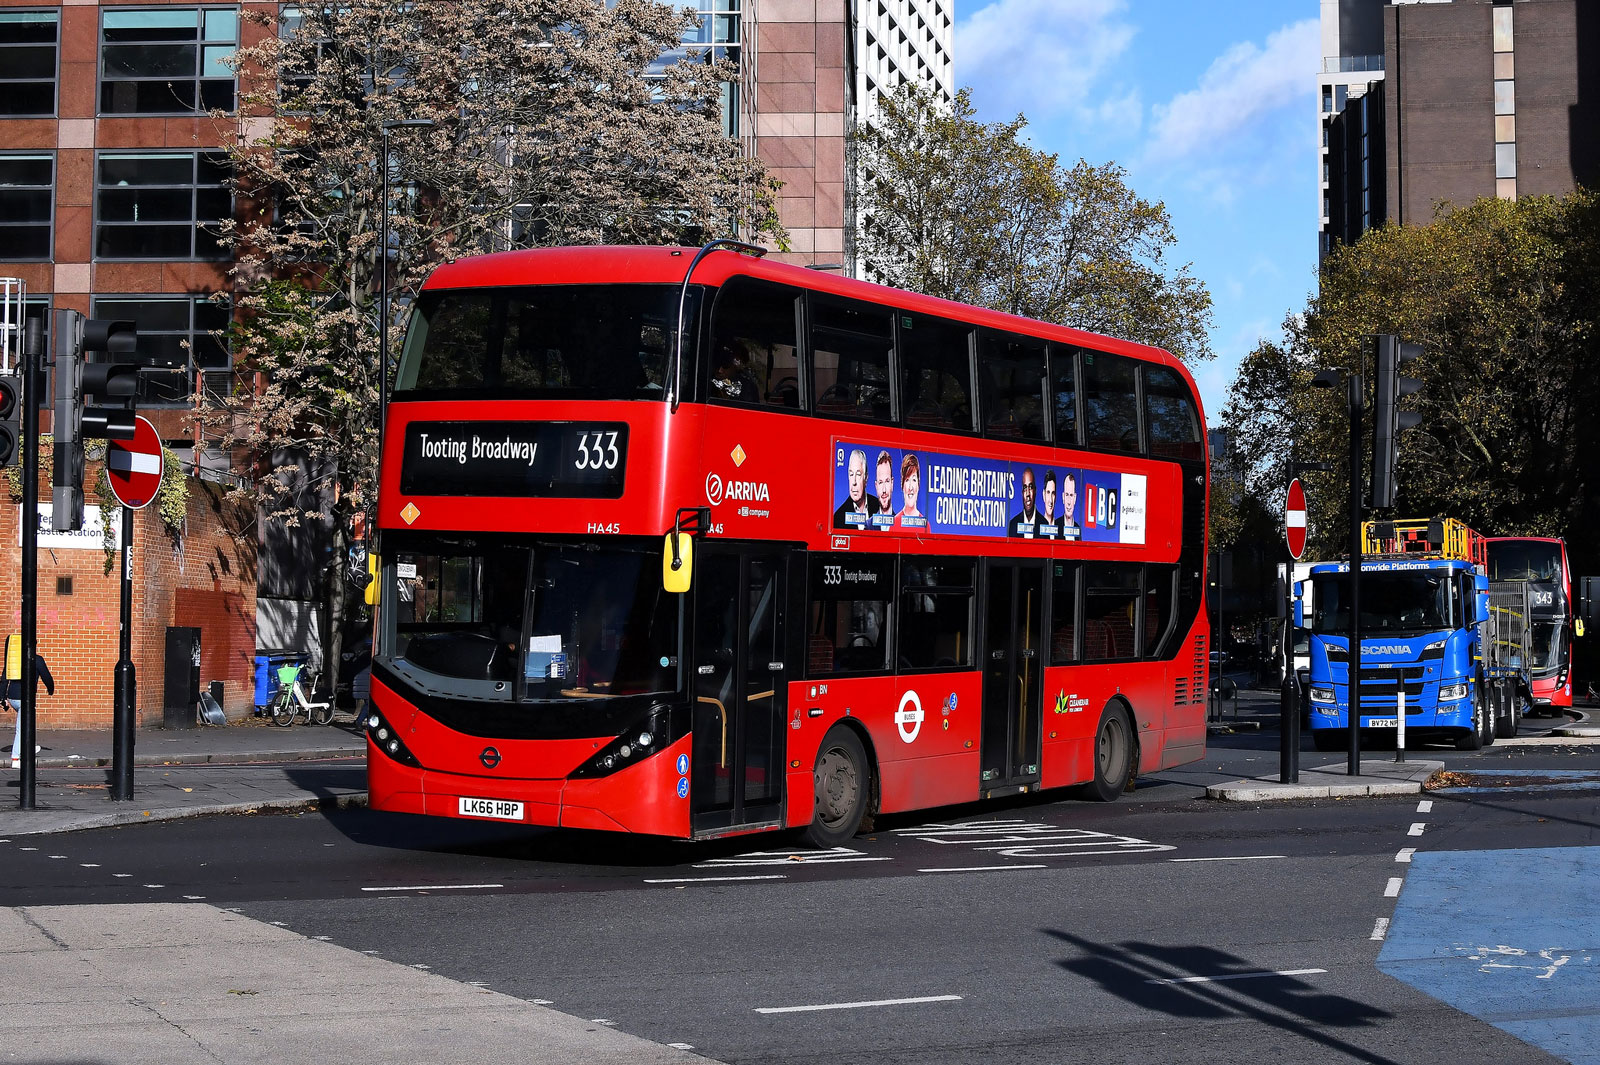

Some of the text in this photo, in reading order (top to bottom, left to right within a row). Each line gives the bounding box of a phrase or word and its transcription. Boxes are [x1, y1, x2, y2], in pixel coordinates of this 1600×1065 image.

[420, 433, 538, 466] Tooting Broadway
[574, 430, 619, 470] 333
[725, 480, 770, 502] ARRIVA
[928, 464, 1015, 500] LEADING BRITAIN'S
[749, 509, 770, 518] company
[936, 496, 1006, 527] CONVERSATION
[1087, 487, 1117, 526] LBC
[587, 522, 620, 534] HA45
[824, 565, 877, 585] 333 Tooting Broadway
[1391, 562, 1430, 571] Platforms
[1535, 592, 1553, 604] 343
[1360, 645, 1412, 655] SCANIA
[819, 684, 828, 695] BN
[464, 799, 519, 817] LK66 HBP
